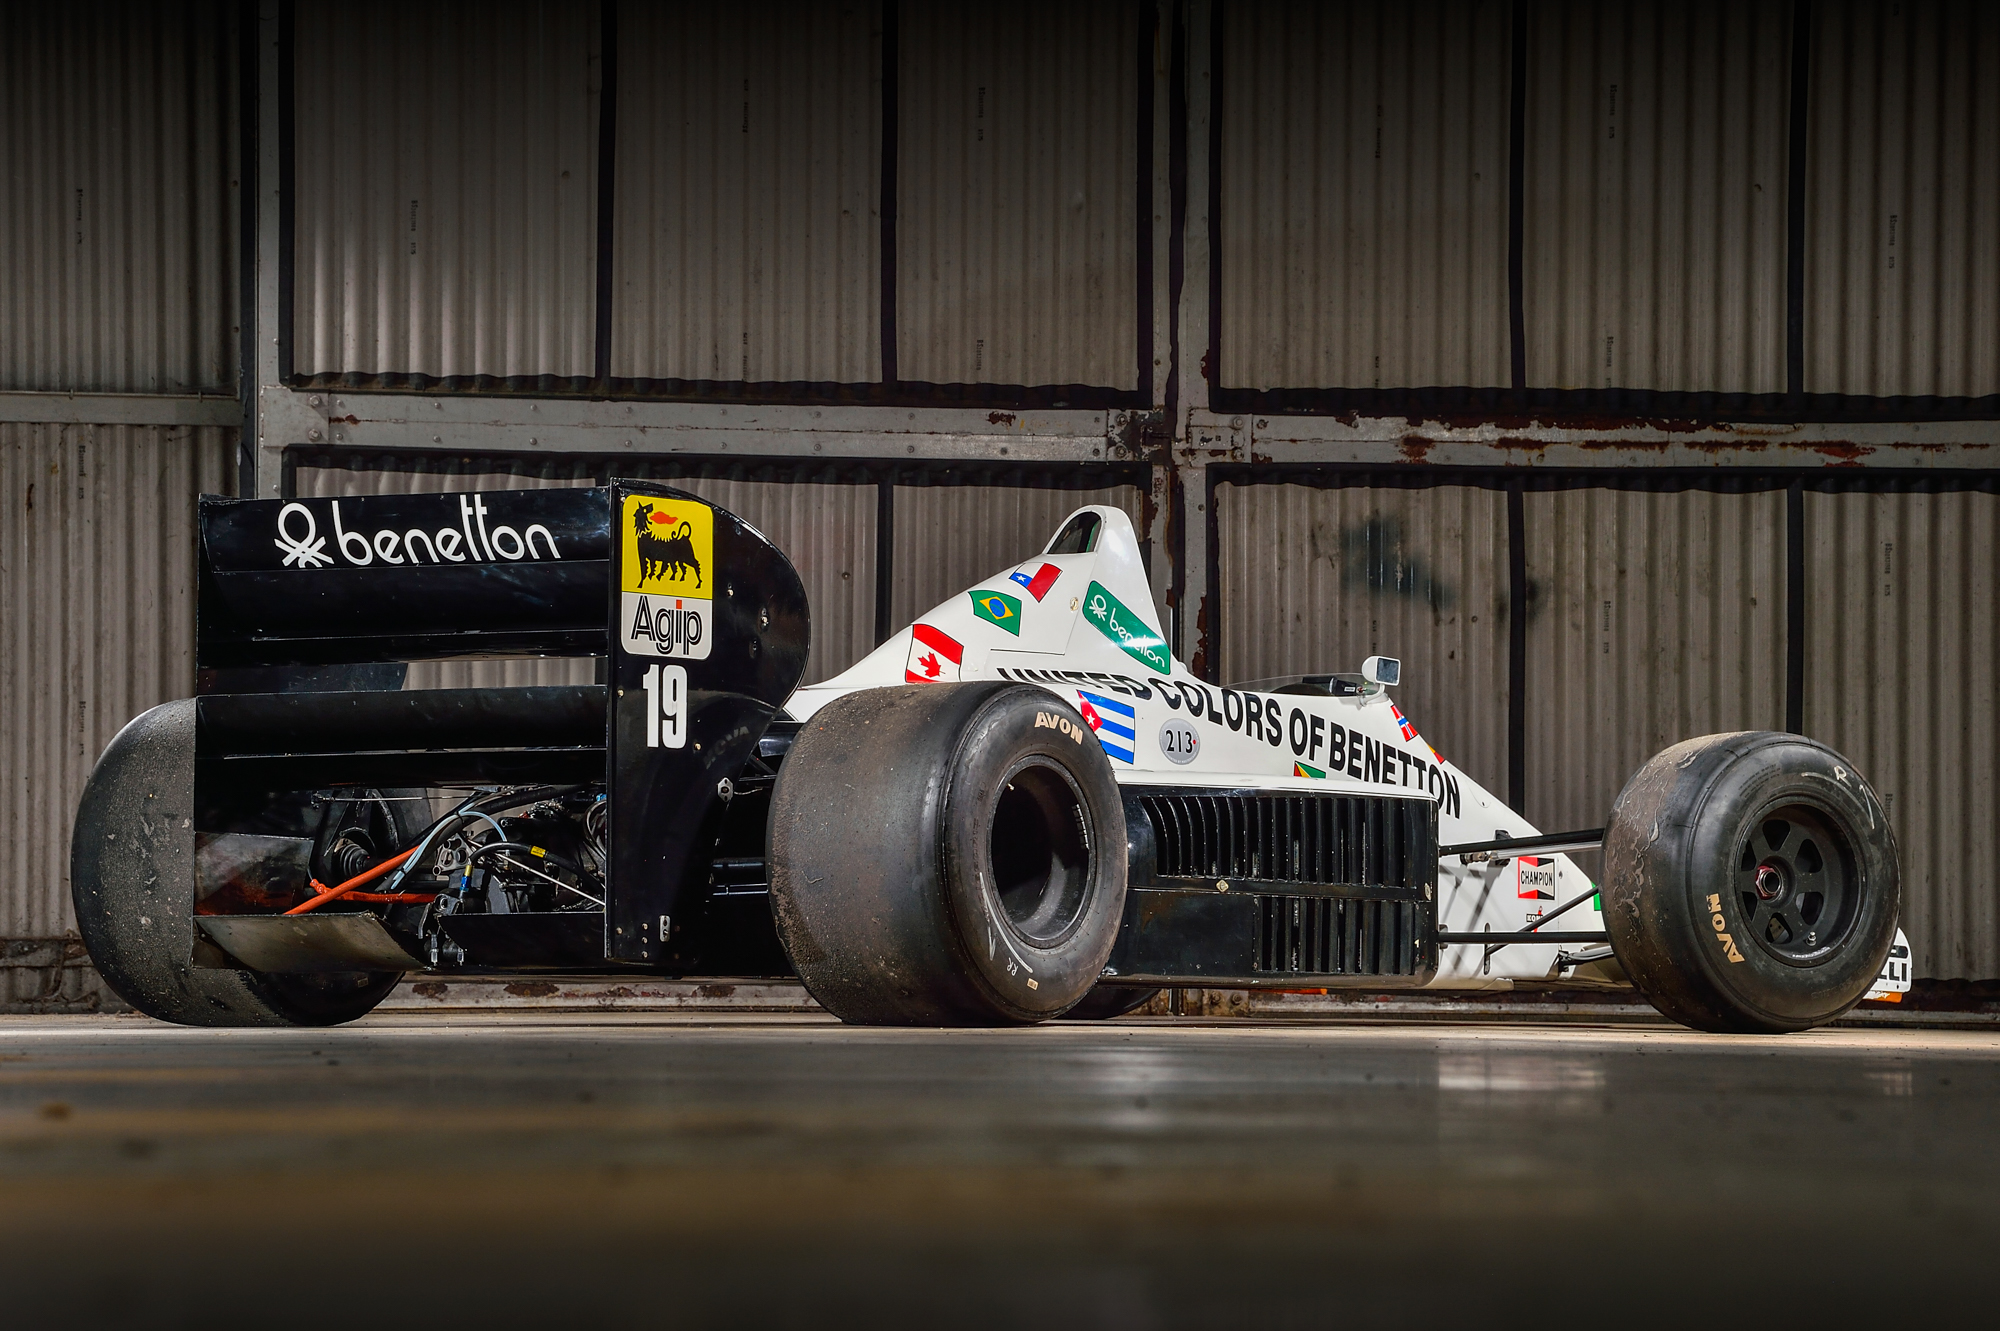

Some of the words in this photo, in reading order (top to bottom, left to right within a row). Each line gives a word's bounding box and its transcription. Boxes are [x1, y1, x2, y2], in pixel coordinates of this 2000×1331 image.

[331, 494, 561, 566] benetton
[630, 595, 702, 656] Agip
[642, 663, 688, 749] 19
[1034, 711, 1083, 745] AVON
[996, 667, 1152, 700] UNITED
[1148, 677, 1282, 747] COLORS
[1289, 707, 1325, 762] OF
[1329, 721, 1461, 820] BENETTON
[1165, 729, 1193, 754] 213
[1520, 870, 1553, 887] CHAMPION
[1706, 892, 1746, 963] AVON
